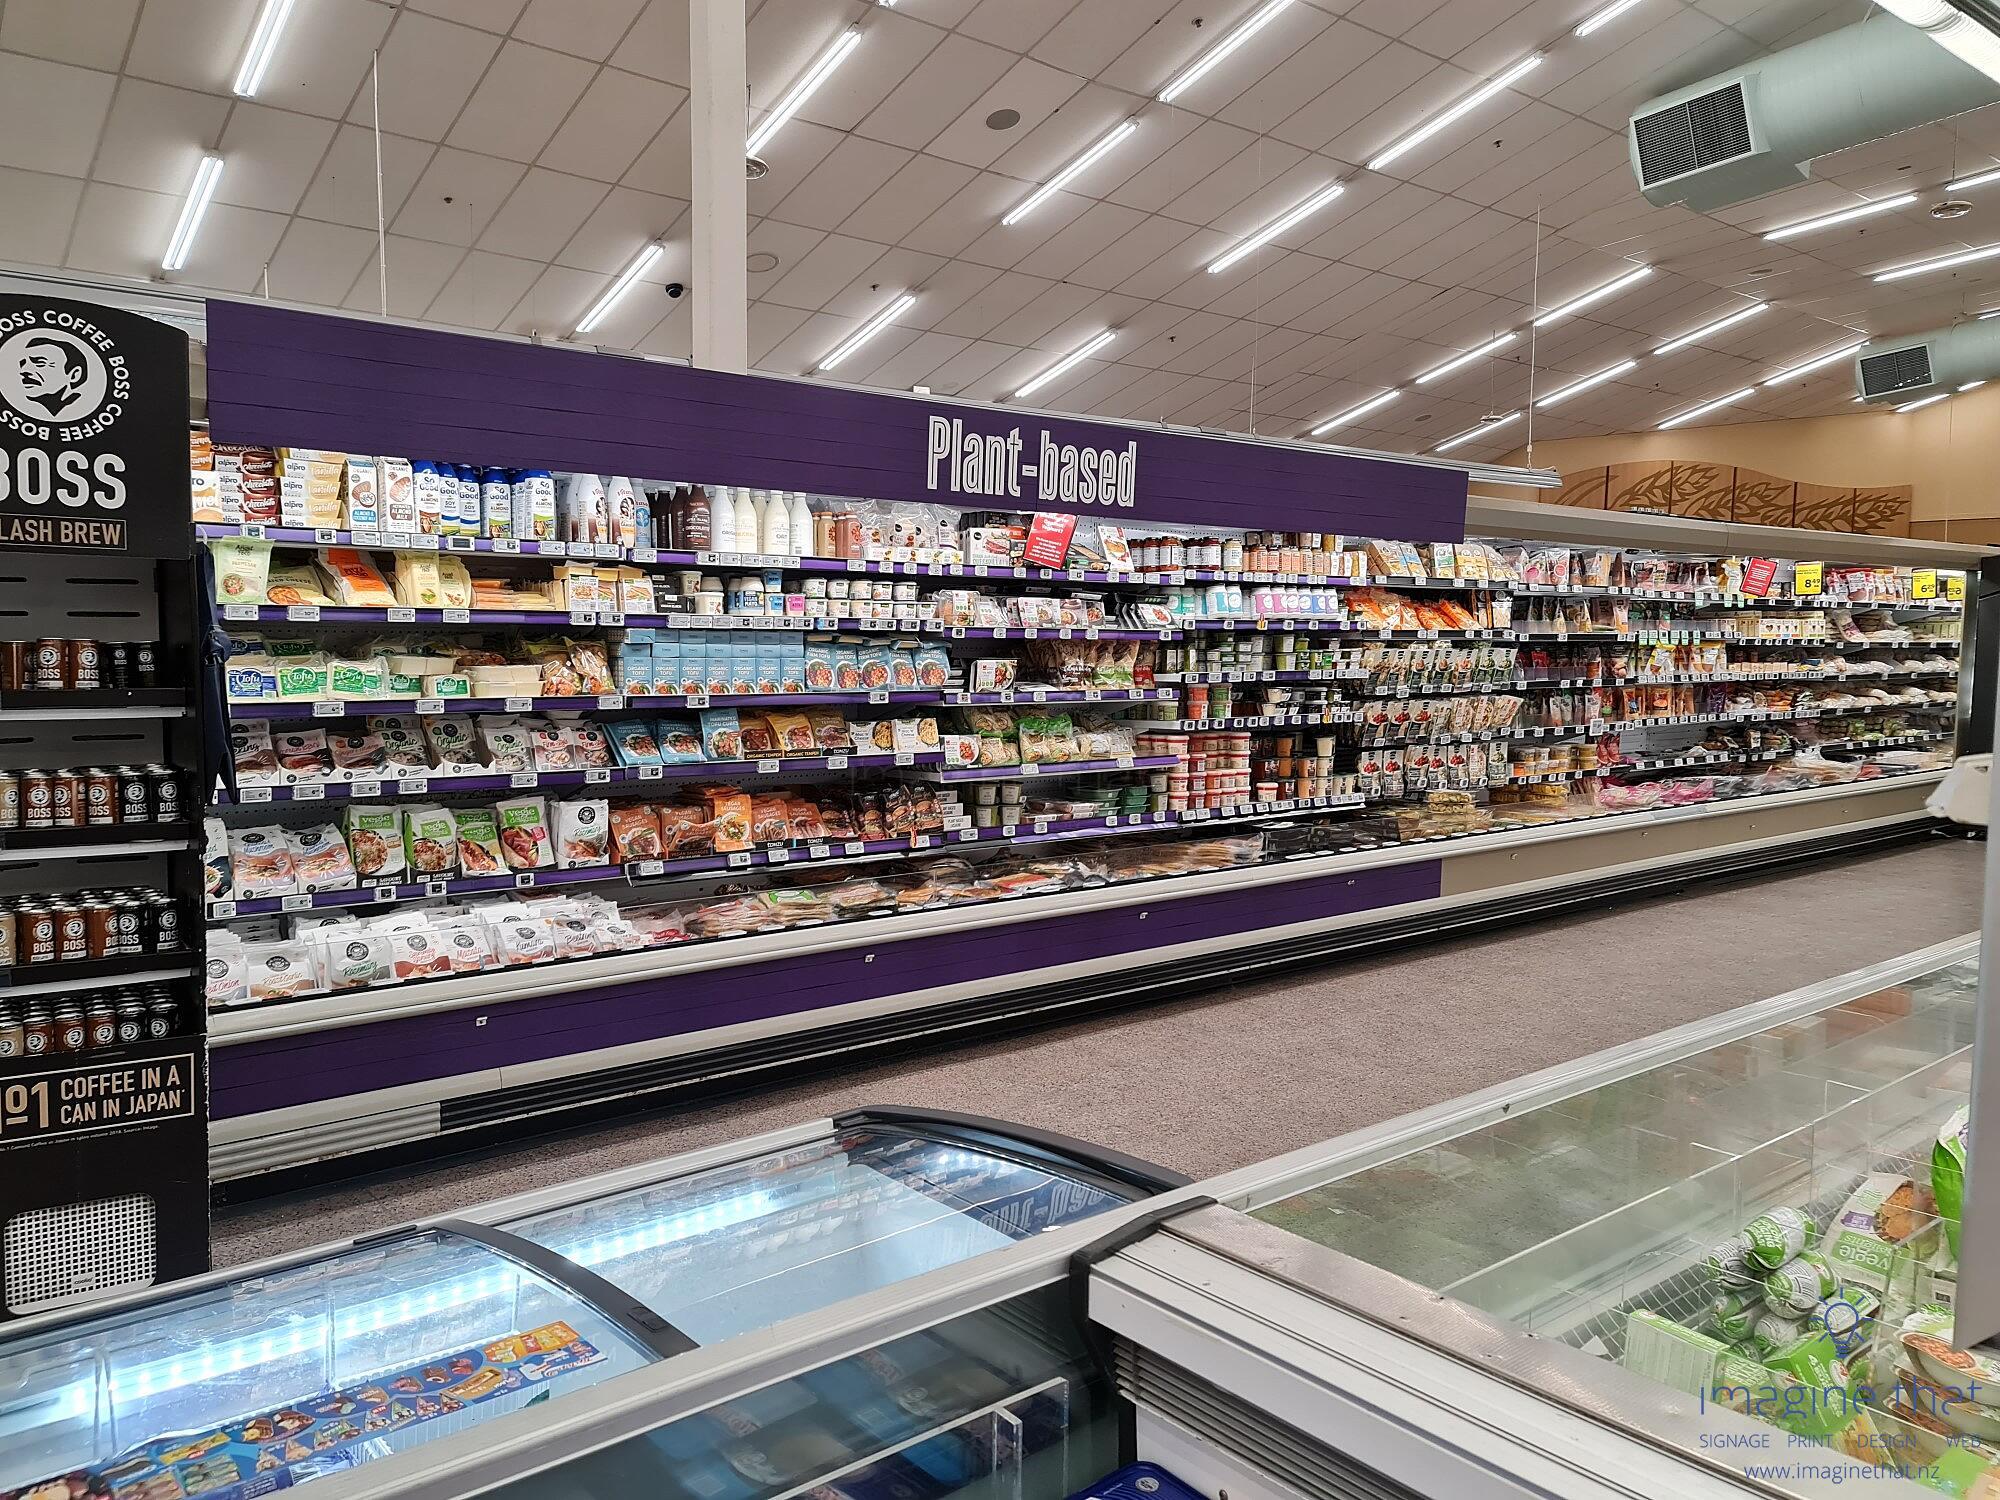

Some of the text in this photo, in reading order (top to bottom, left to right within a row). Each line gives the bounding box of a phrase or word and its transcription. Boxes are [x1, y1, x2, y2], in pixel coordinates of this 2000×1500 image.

[0, 310, 36, 338] OSS
[43, 310, 115, 352] COFFEE
[109, 355, 130, 400] BOSS
[60, 403, 122, 442] COFFEE
[218, 460, 238, 468] alpro
[287, 463, 306, 471] alpro
[927, 415, 1137, 507] Plant-based
[460, 492, 479, 500] Good
[60, 522, 122, 546] BREW
[78, 670, 99, 680] BOSS
[242, 672, 260, 682] Tofu
[292, 672, 313, 681] Tofu
[385, 739, 417, 751] Organic
[436, 733, 468, 749] Organic
[27, 808, 51, 818] BOSS
[55, 807, 71, 817] OSS
[125, 804, 148, 814] BOSS
[509, 807, 536, 818] vegie
[362, 815, 390, 824] vegie
[622, 819, 648, 829] SAUSAGES
[33, 941, 54, 953] BOSS
[63, 939, 86, 951] BOSS
[343, 961, 378, 976] Rosemary
[60, 1064, 181, 1101] COFFEE IN A
[60, 1101, 97, 1125] CAN
[103, 1097, 120, 1118] IN
